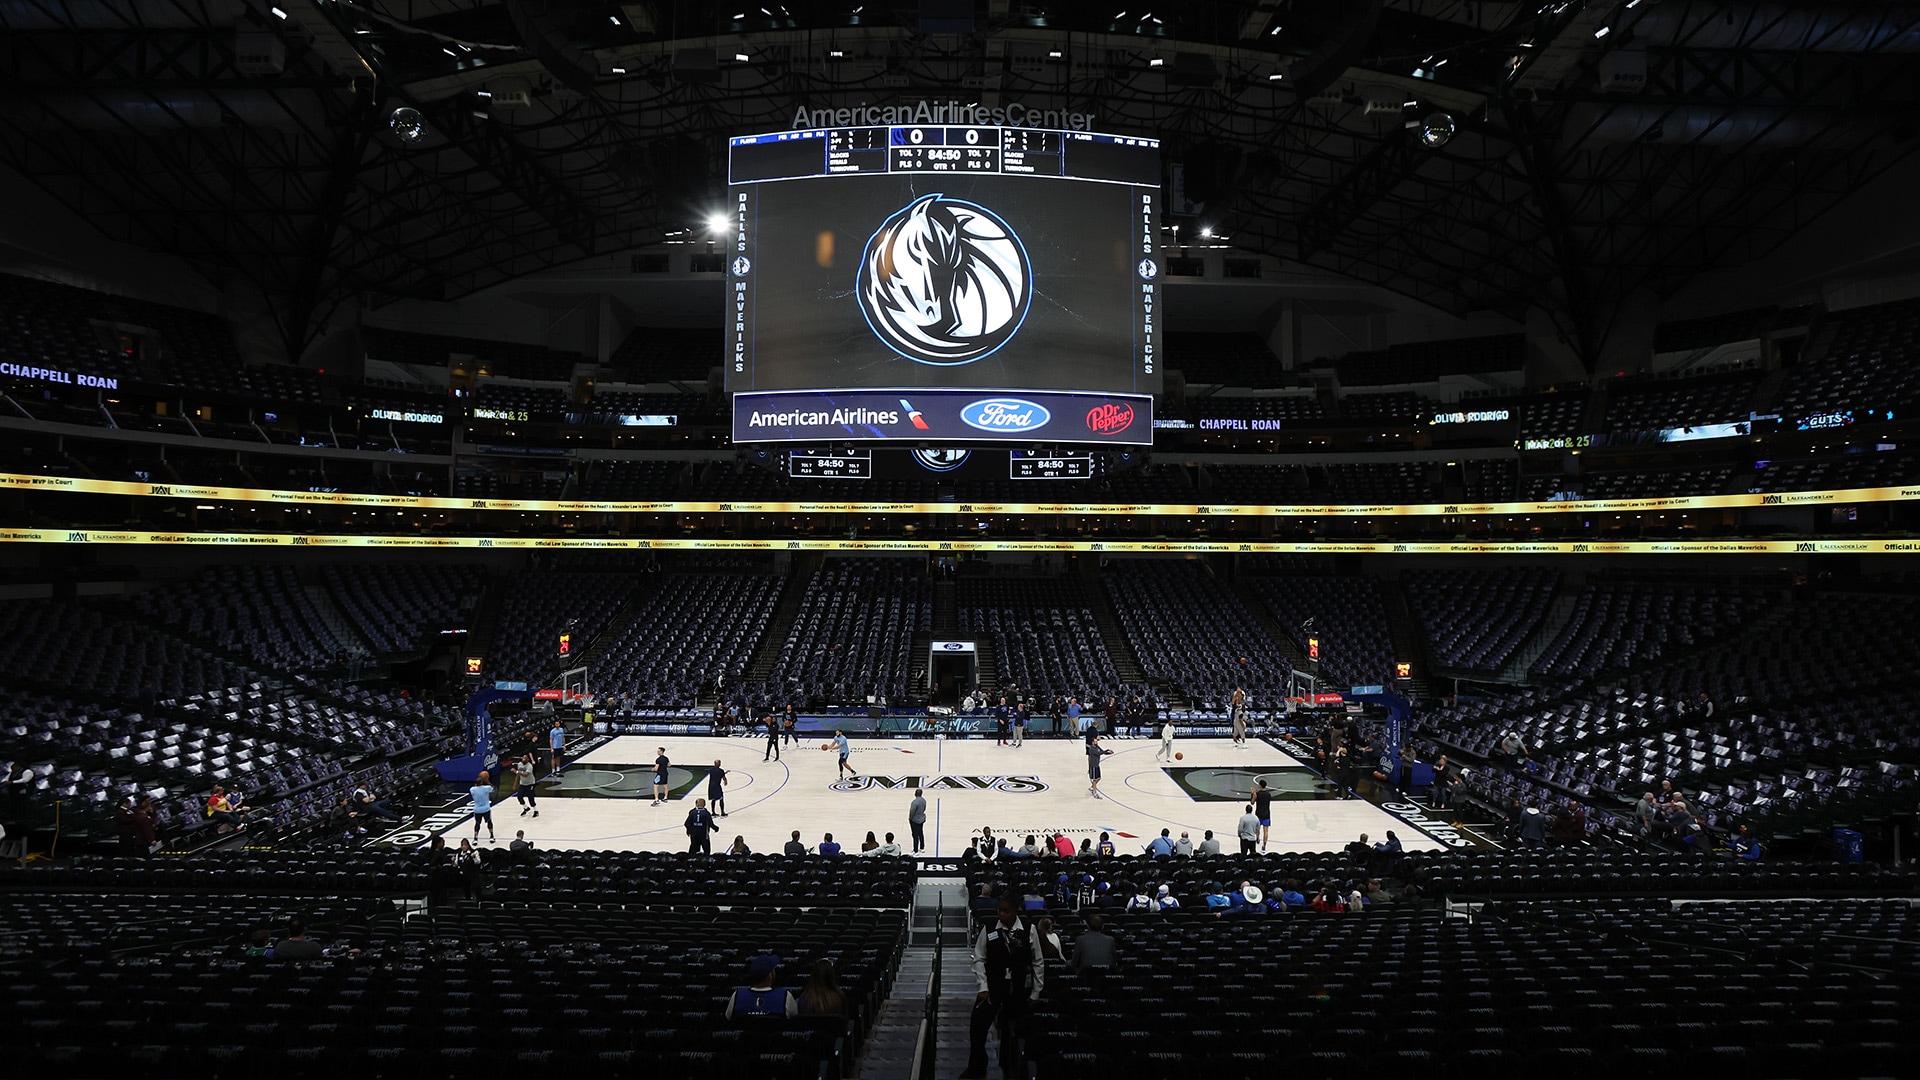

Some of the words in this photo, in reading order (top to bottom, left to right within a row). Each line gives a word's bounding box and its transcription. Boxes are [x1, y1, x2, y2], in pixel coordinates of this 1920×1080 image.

[910, 129, 924, 144] 0
[965, 129, 979, 144] 0
[899, 149, 913, 157] TOL
[917, 149, 922, 157] 7
[927, 149, 961, 160] 84:50
[899, 160, 912, 168] FLS
[916, 160, 922, 168] 0
[737, 193, 747, 251] DALLAS
[1142, 195, 1152, 253] DALLAS
[735, 282, 747, 372] MAVERICKS
[1142, 284, 1153, 374] MAVERICKS
[0, 362, 71, 384] CHAPPELL
[77, 374, 117, 389] ROAN
[517, 411, 528, 421] 25
[978, 403, 1033, 427] Ford
[1103, 403, 1120, 417] Dr
[1467, 410, 1509, 423] RODRIGO
[404, 412, 443, 424] RODRIGO
[749, 409, 829, 427] American
[830, 408, 899, 425] Airlines
[1091, 405, 1130, 431] Pepper
[1809, 414, 1843, 425] GUTS
[1199, 419, 1248, 430] CHAPPELL
[1251, 419, 1280, 430] ROAN
[1576, 435, 1590, 447] 25
[817, 459, 844, 468] 84:50
[1037, 461, 1064, 469] 84:50
[829, 775, 1049, 793] MAVS
[1381, 802, 1476, 847] Dallas
[1102, 847, 1111, 856] 12
[916, 861, 959, 871] las
